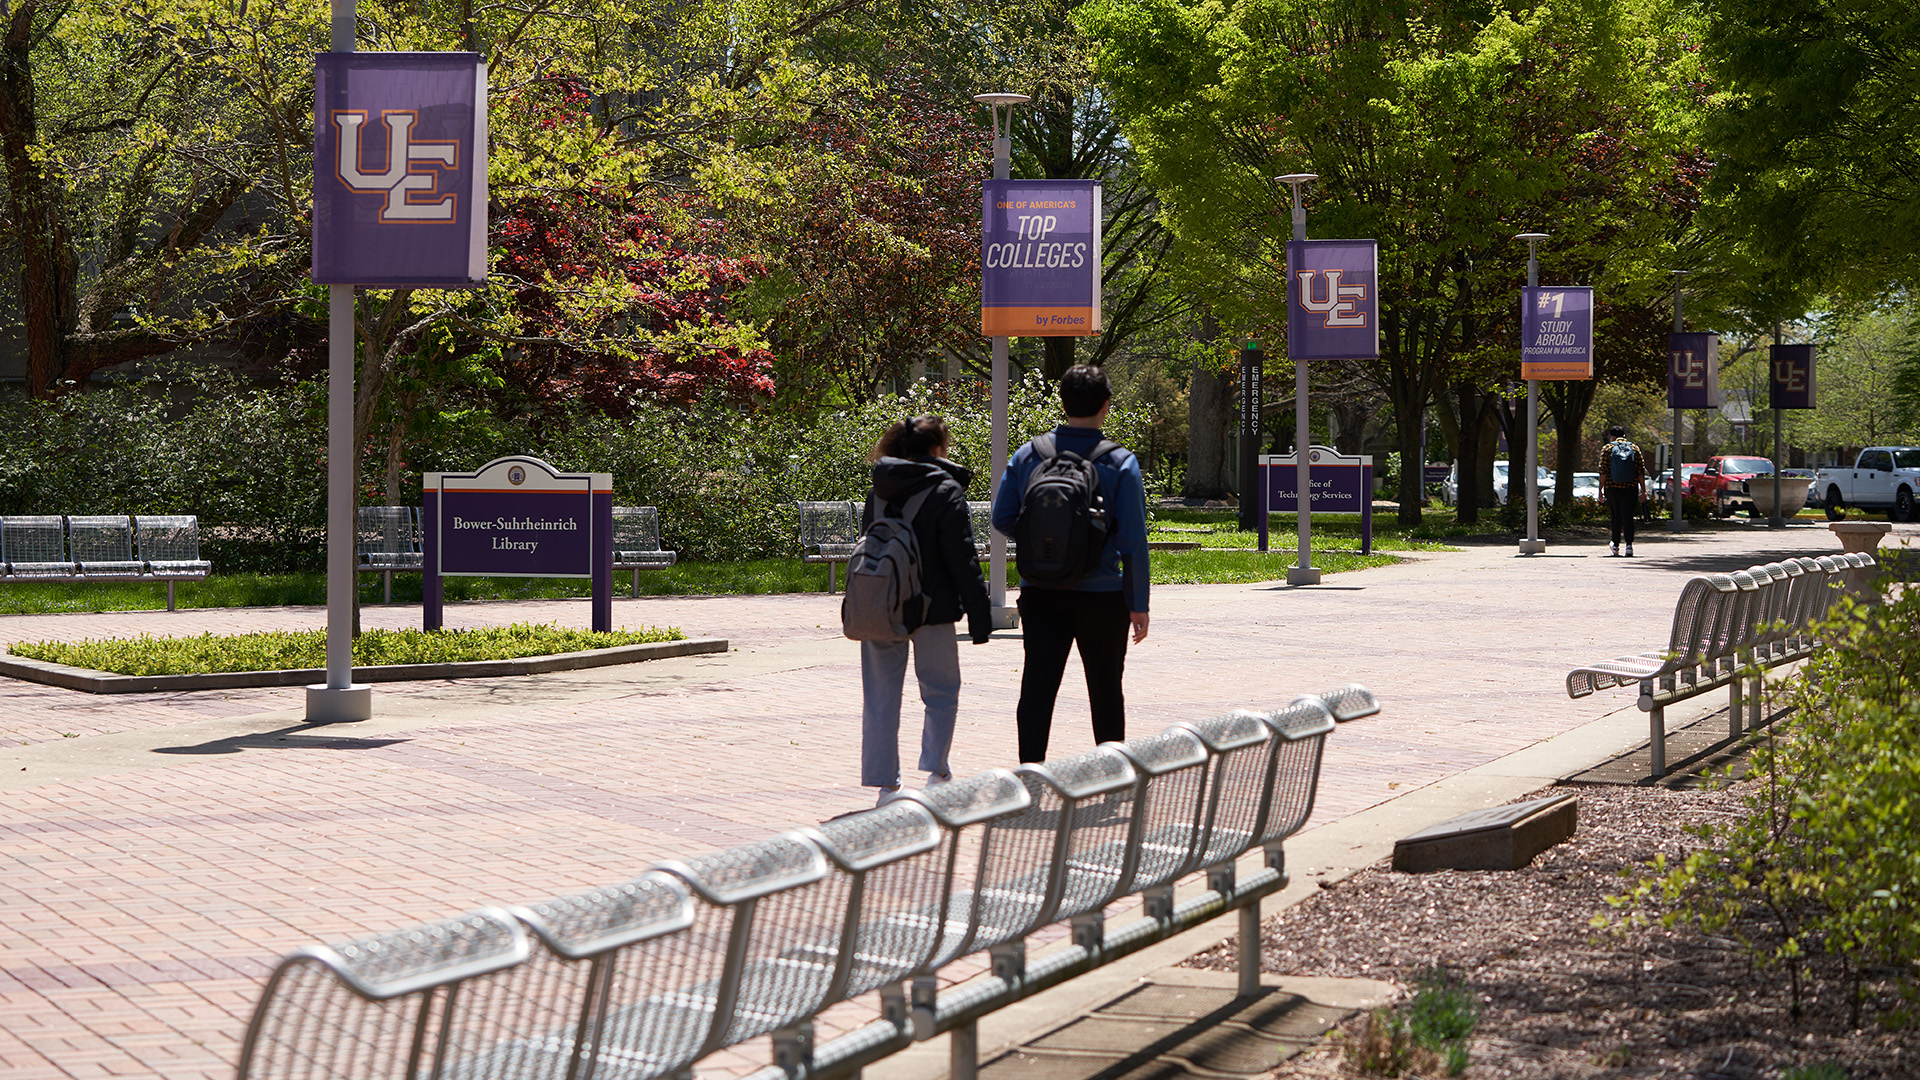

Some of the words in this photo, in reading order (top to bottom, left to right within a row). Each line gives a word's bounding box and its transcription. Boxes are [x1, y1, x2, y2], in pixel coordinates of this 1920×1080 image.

[331, 109, 460, 224] UE
[996, 201, 1014, 209] ONE
[1016, 201, 1028, 209] OF
[1029, 201, 1077, 209] AMERICA'S
[1018, 215, 1057, 241] TOP
[986, 242, 1087, 269] COLLEGES
[1296, 269, 1367, 328] UE
[1538, 292, 1565, 318] #1
[1036, 315, 1048, 326] by
[1051, 315, 1085, 325] Forbes
[1540, 321, 1573, 333] STUDY
[1535, 334, 1576, 346] ABROAD
[1672, 351, 1705, 389] UE
[1773, 360, 1806, 392] UE
[1251, 366, 1260, 436] EMERGENCY
[1323, 480, 1333, 488] of
[1278, 490, 1321, 501] Techgy
[1322, 490, 1353, 499] Services
[453, 516, 577, 531] Bower-Suhrheinrich
[492, 537, 539, 554] Library
